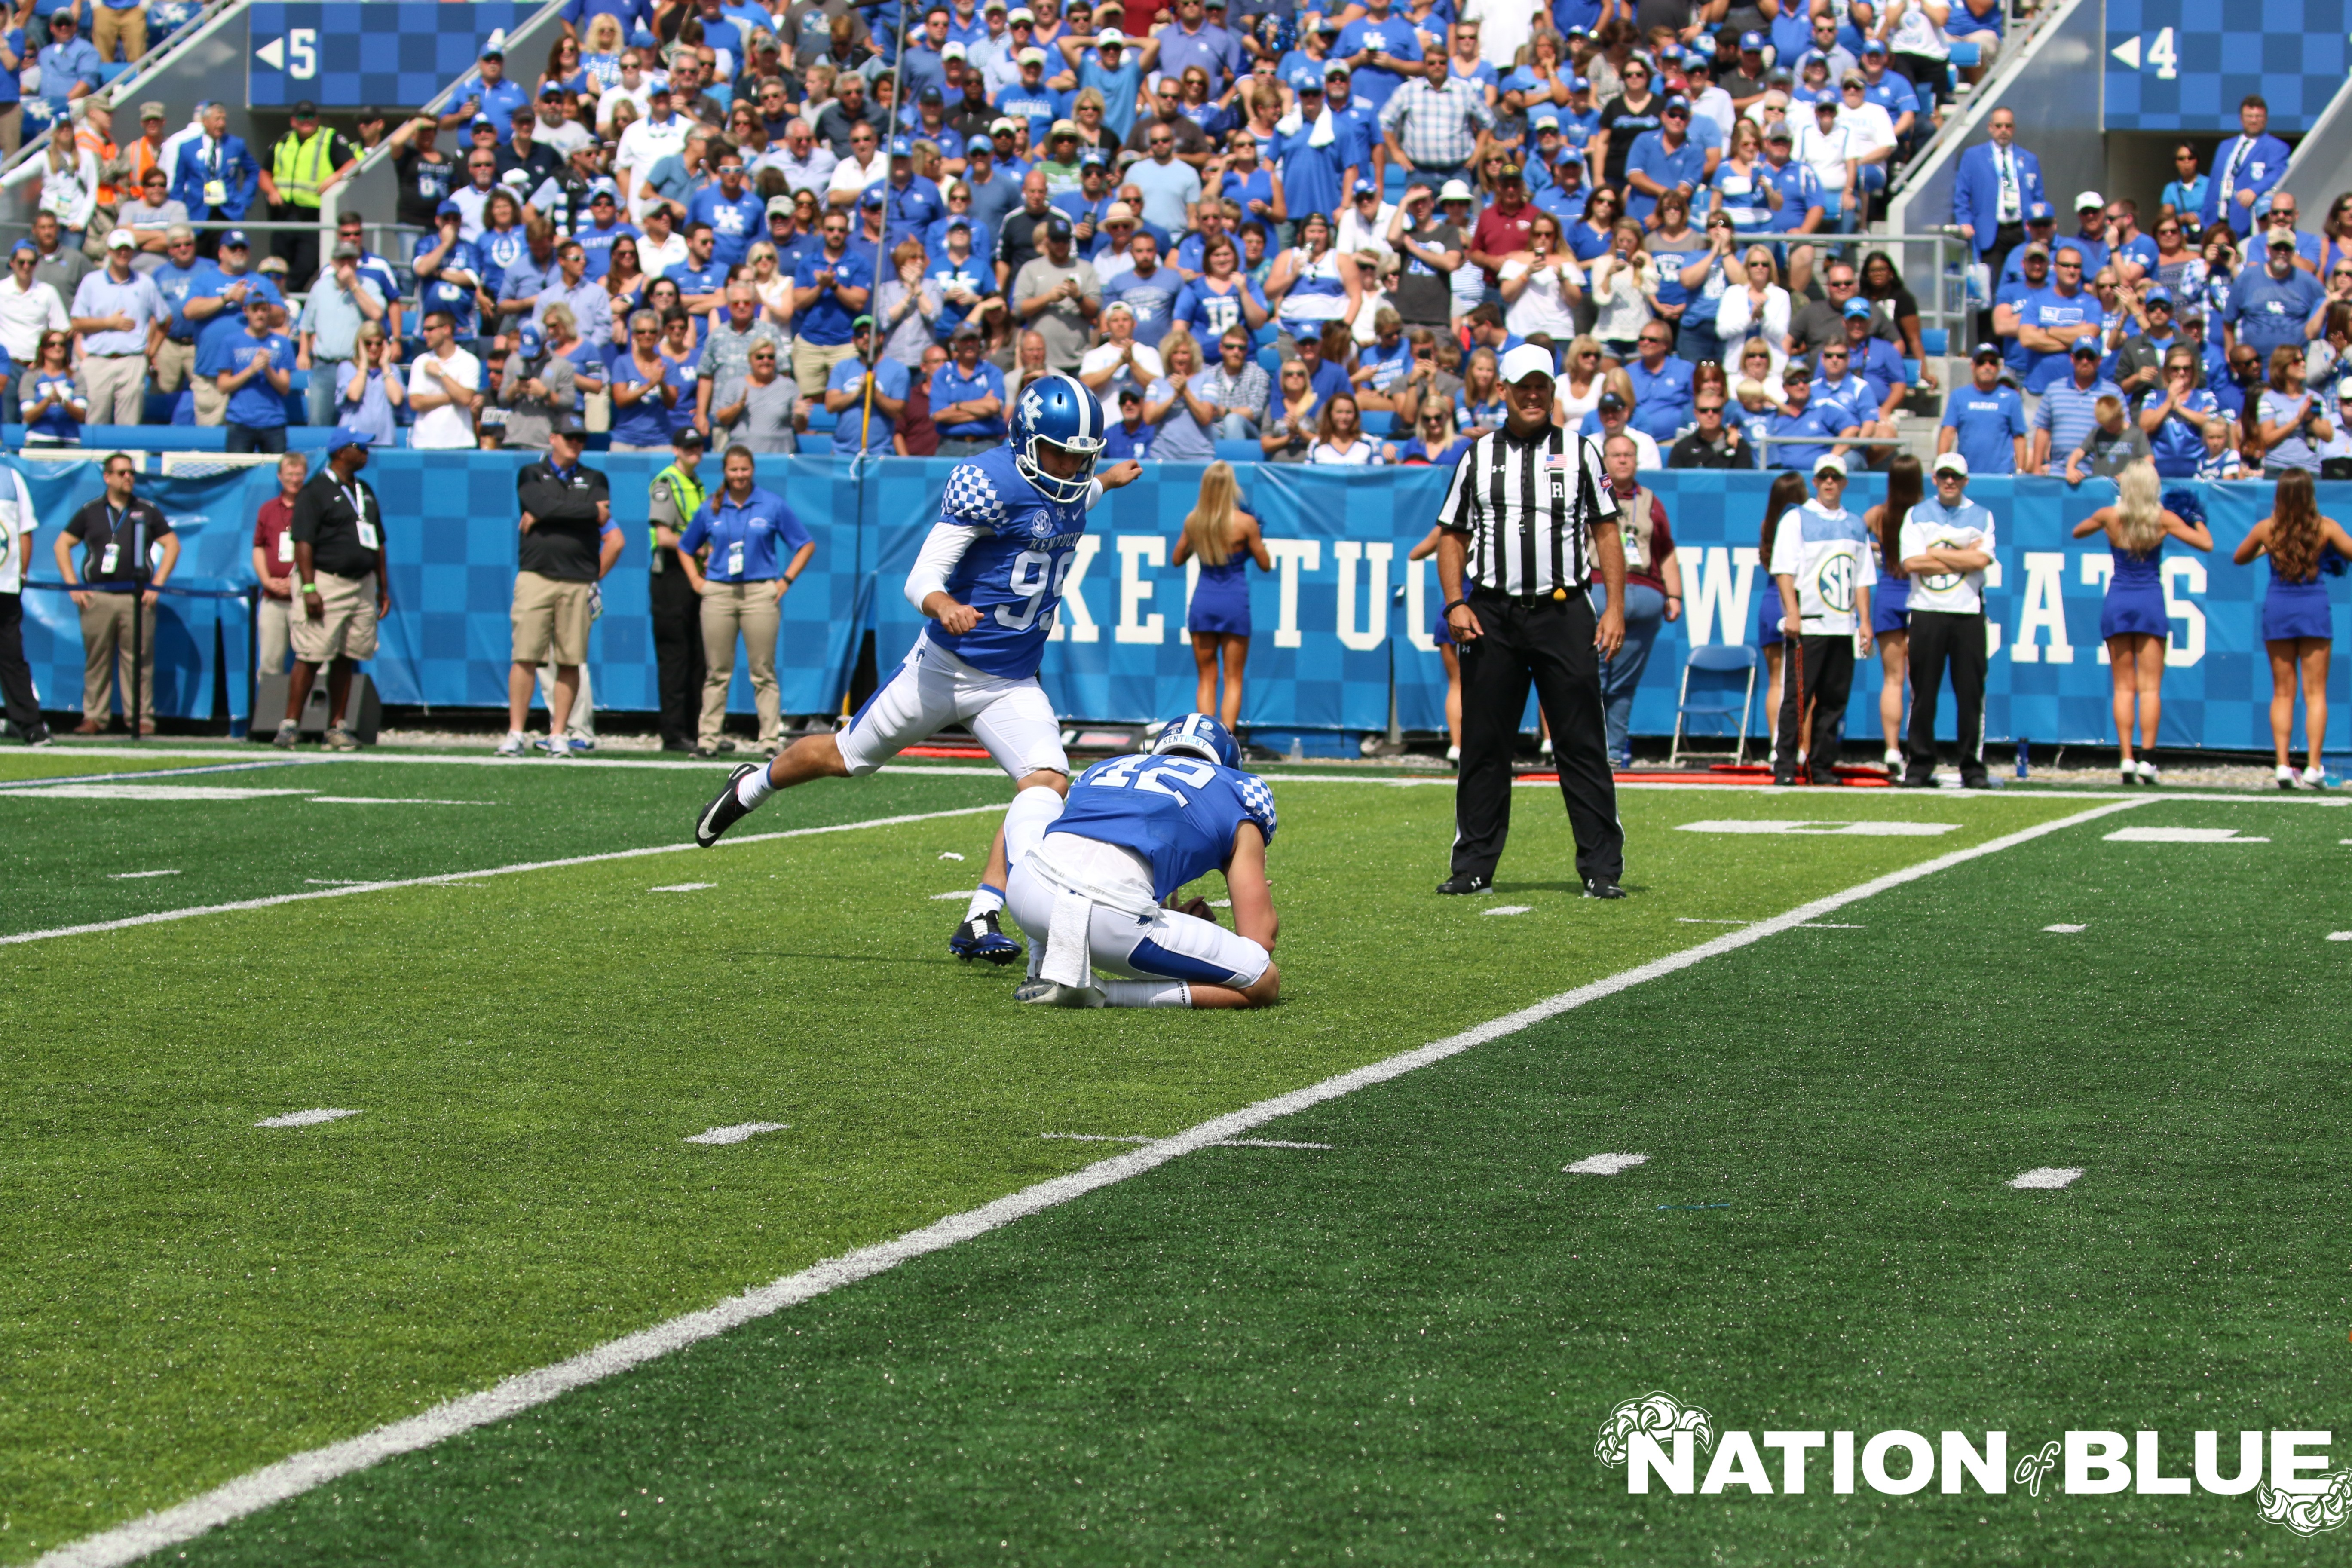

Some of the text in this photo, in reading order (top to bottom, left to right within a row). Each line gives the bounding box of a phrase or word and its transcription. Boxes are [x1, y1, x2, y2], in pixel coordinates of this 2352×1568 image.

[289, 28, 317, 80] 5
[2147, 26, 2177, 80] 4
[1552, 481, 1564, 498] R
[1033, 511, 1050, 530] SEC
[1819, 556, 1854, 610] SE
[1163, 734, 1208, 749] KENTUCKY
[1089, 754, 1217, 808] 42
[1086, 884, 1105, 896] LOCK
[971, 919, 989, 940] NIKE
